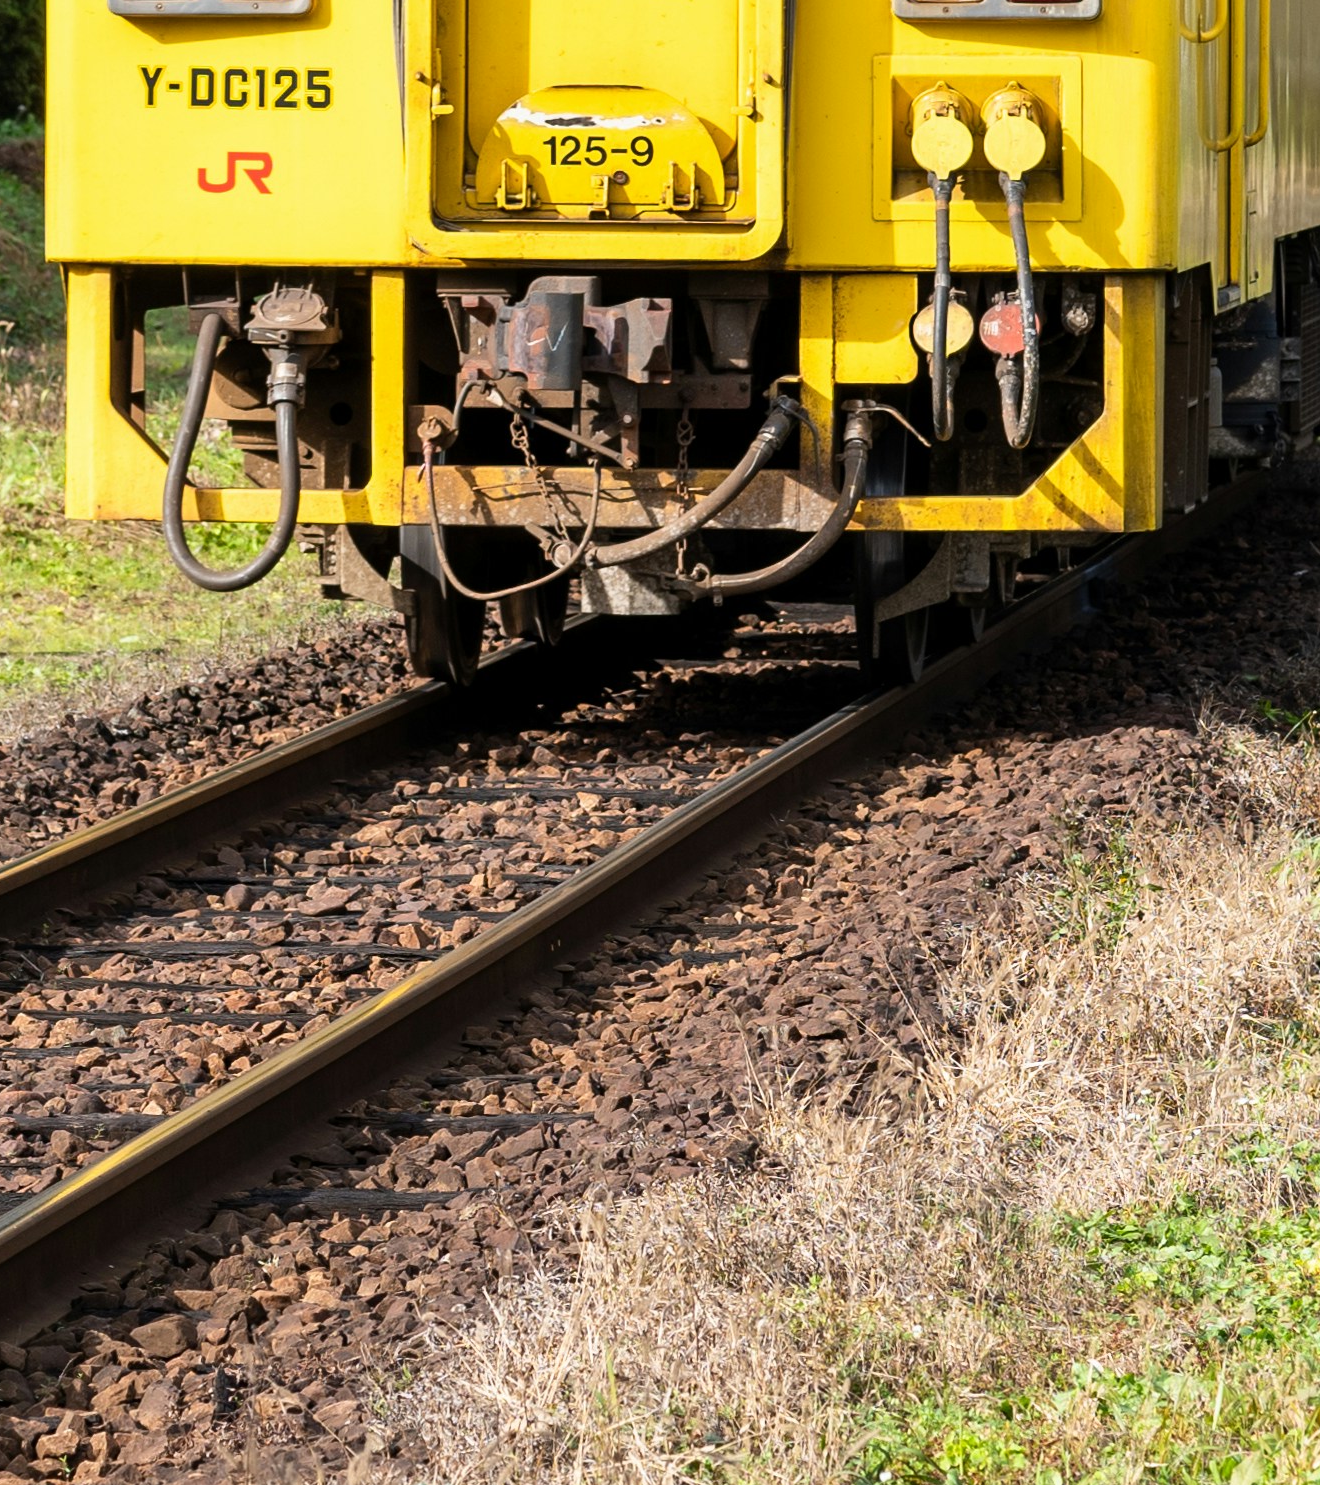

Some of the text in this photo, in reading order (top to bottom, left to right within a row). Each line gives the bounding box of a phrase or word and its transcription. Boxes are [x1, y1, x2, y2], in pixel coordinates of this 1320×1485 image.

[139, 66, 332, 110] Y-DC125
[198, 151, 273, 194] JR
[543, 135, 654, 167] 125-9
